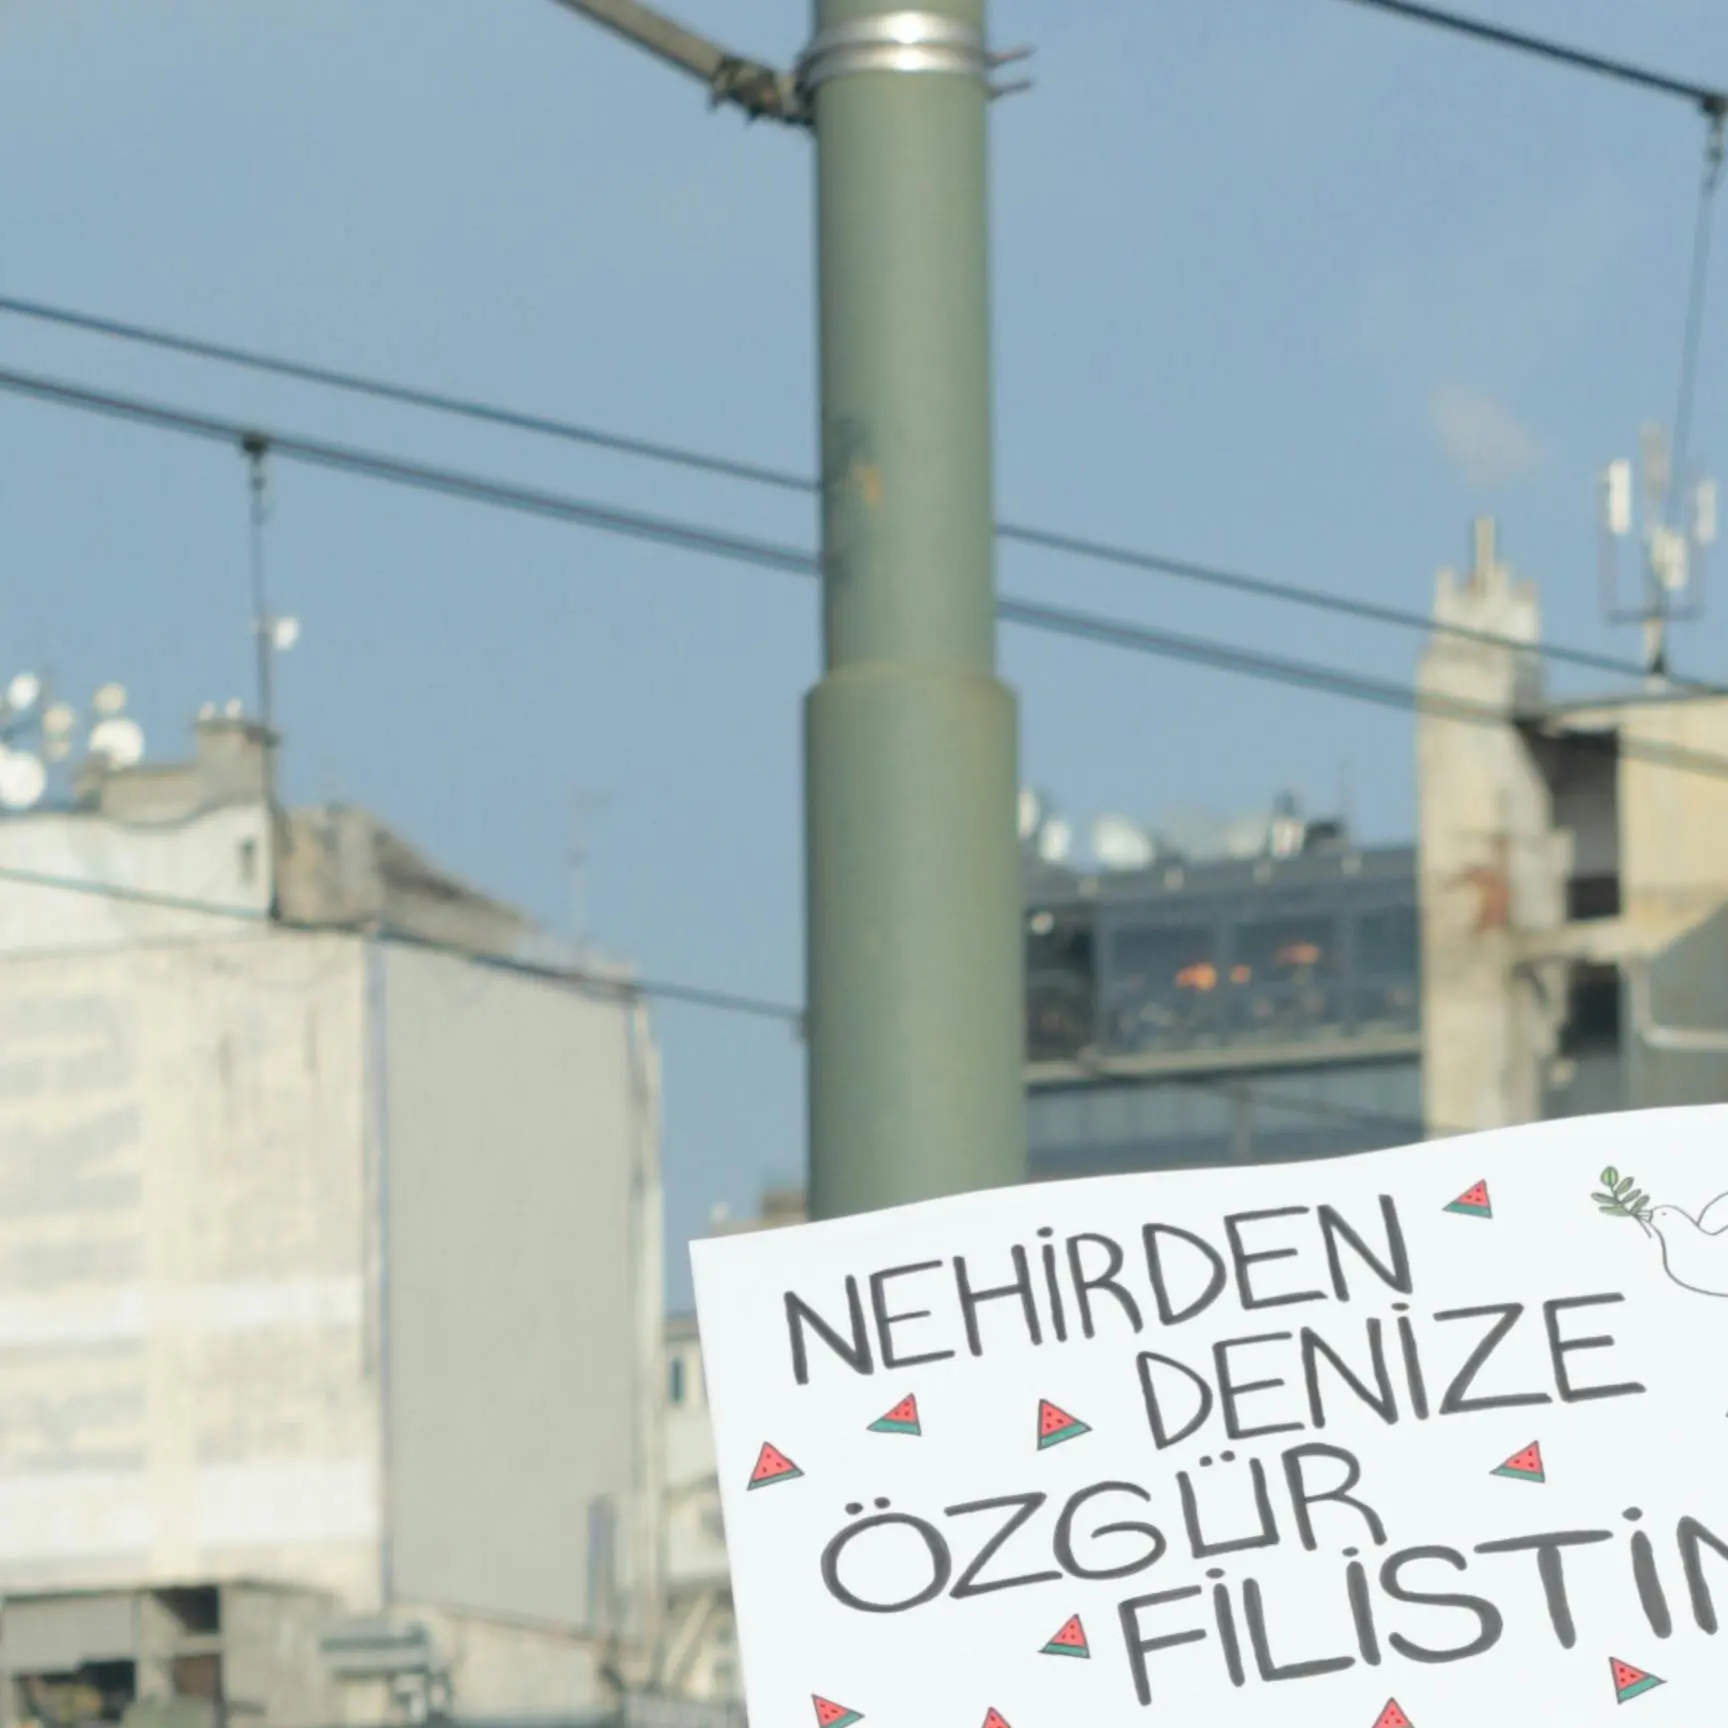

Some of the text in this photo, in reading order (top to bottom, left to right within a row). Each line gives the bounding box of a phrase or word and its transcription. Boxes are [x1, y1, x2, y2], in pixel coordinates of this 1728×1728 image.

[785, 1195, 1412, 1384] NEHİRDEN
[1137, 1293, 1645, 1449] DENİZE
[822, 1443, 1386, 1612] ÖZGÜR
